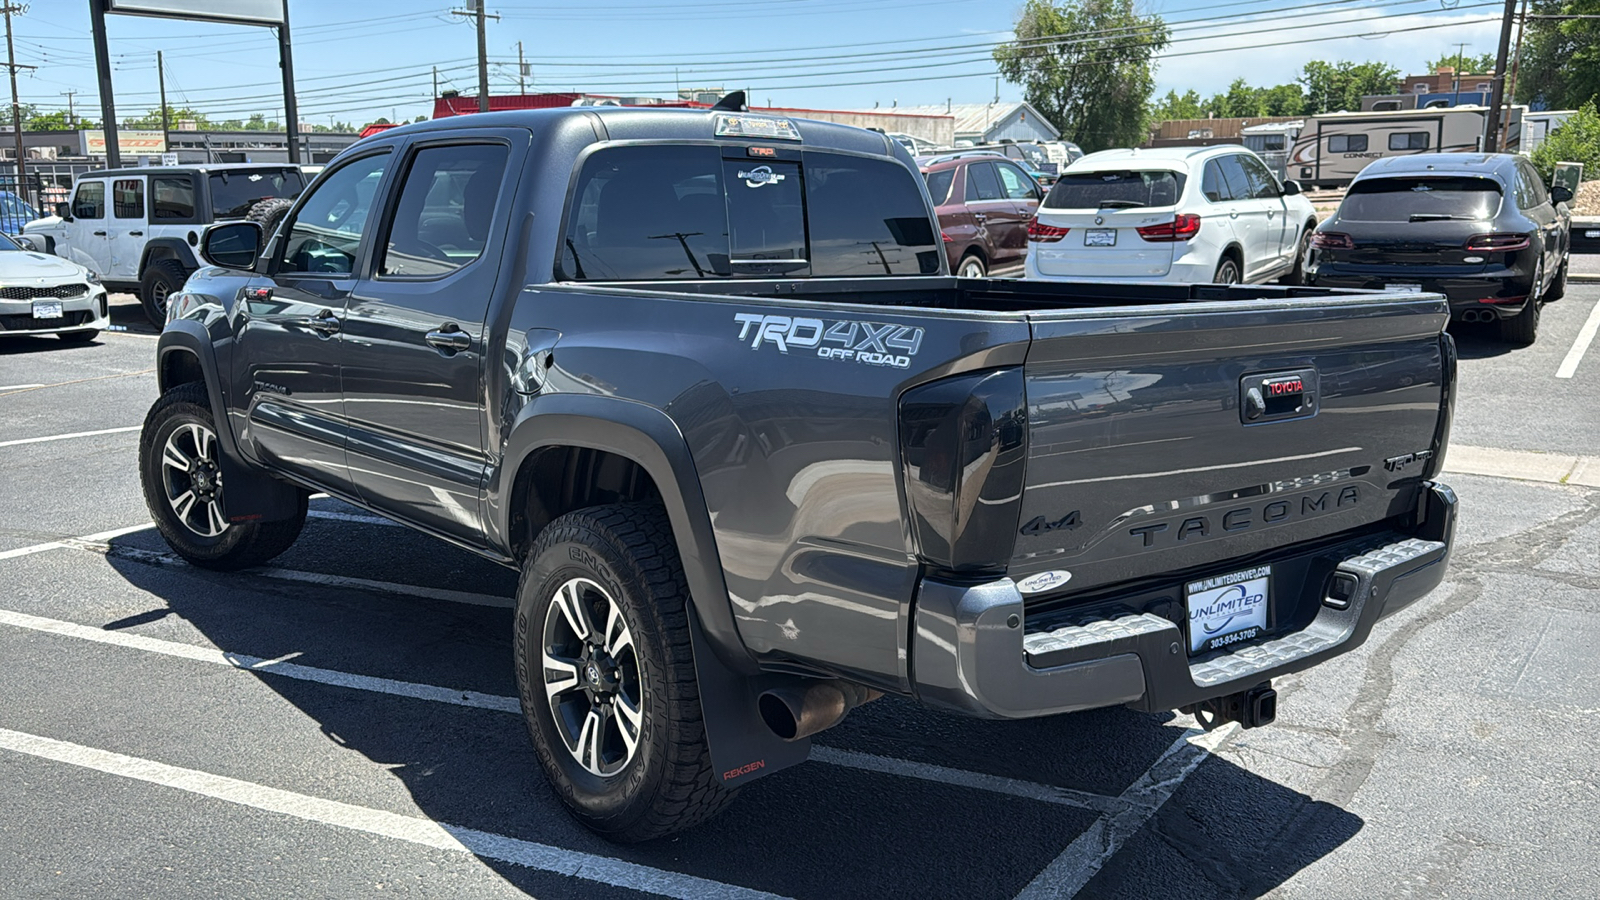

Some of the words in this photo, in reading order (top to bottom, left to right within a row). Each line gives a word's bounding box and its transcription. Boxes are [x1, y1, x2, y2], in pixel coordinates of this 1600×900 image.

[751, 147, 774, 156] TRD
[734, 313, 824, 354] TRD
[817, 347, 854, 362] OFF
[855, 350, 911, 369] ROAD
[1269, 381, 1303, 395] TOYOTA
[1383, 453, 1413, 472] TRD
[1128, 486, 1361, 547] TACOMA
[1024, 575, 1062, 587] UNLIMITED
[1189, 594, 1263, 619] UNLIMITED
[1210, 628, 1256, 649] 303-934-3705
[517, 611, 563, 781] SUMITOMO
